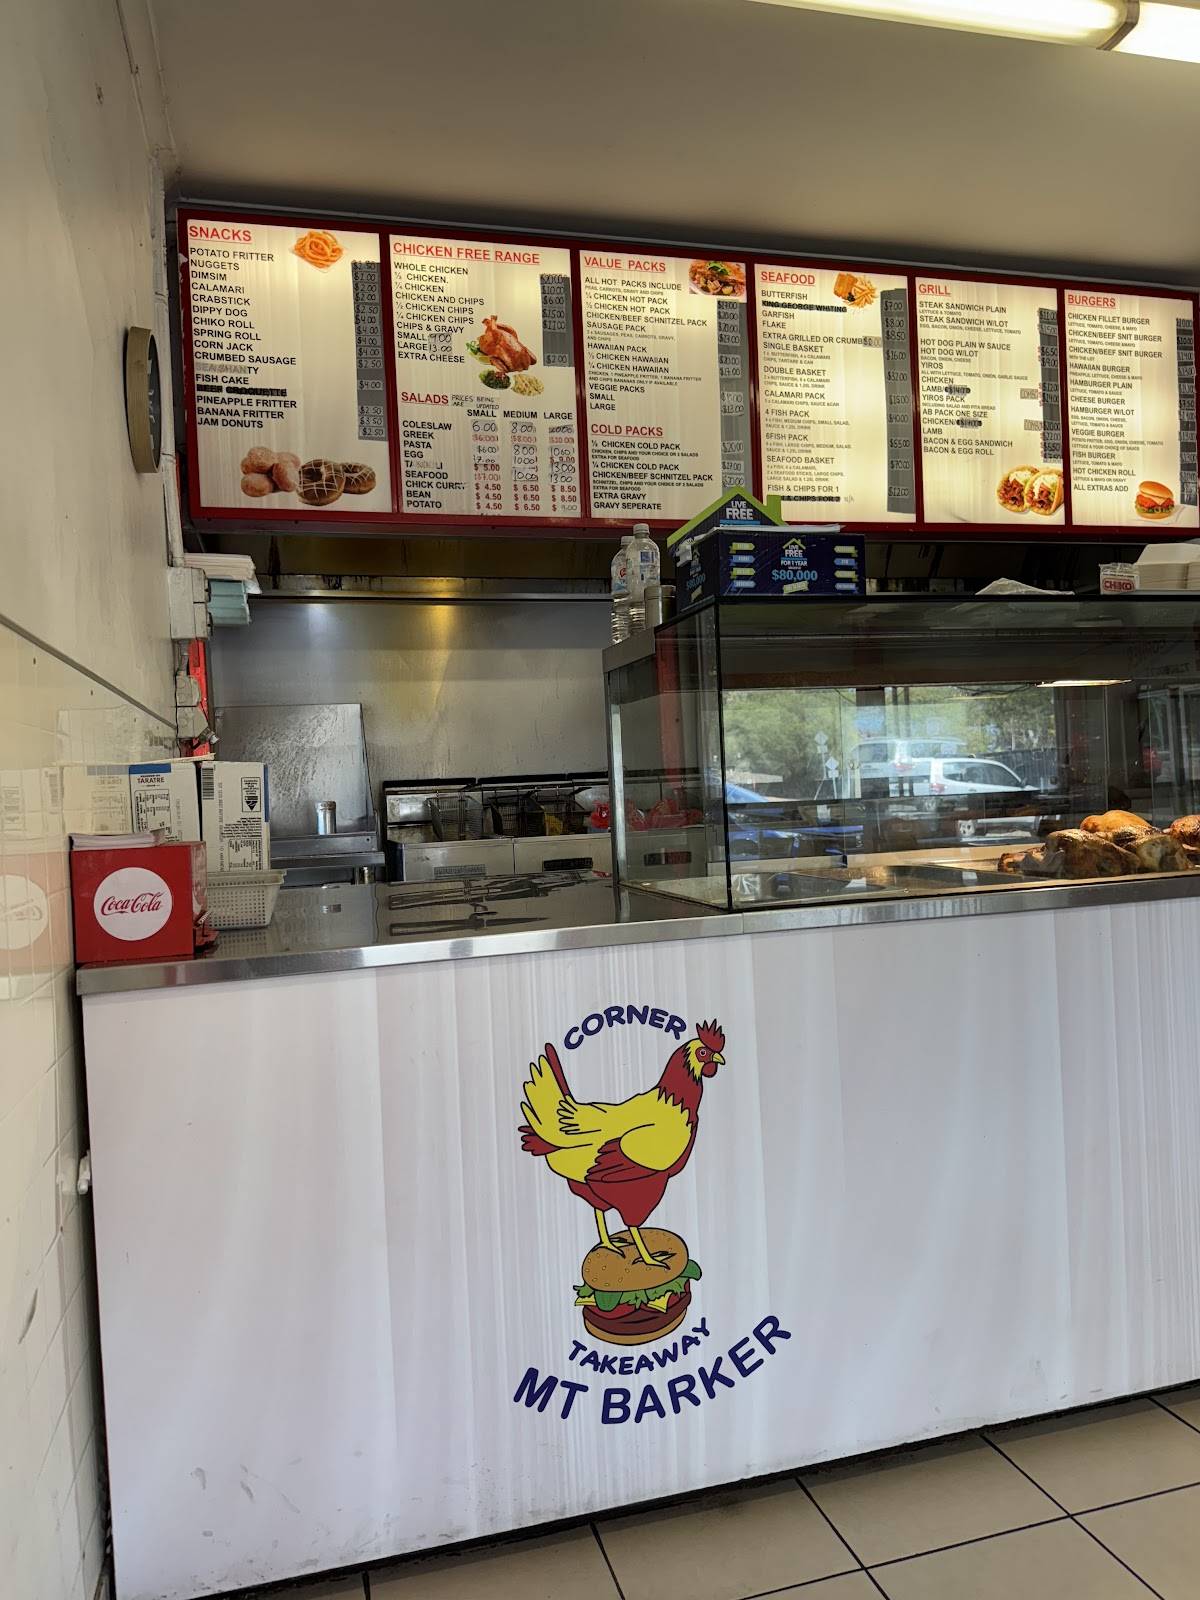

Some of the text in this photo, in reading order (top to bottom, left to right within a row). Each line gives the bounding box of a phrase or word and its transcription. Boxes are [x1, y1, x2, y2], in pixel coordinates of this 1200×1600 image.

[189, 226, 251, 241] SNACKS
[190, 248, 274, 261] POTATO FRITTER
[393, 243, 540, 263] CHICKEN FREE RANGE
[190, 259, 239, 270] NUGGETS
[394, 262, 468, 274] WHOLE CHICKEN
[584, 257, 666, 272] VALUE PACKS
[191, 271, 227, 281] DIMSIM
[761, 272, 815, 284] SEAFOOD
[192, 283, 244, 293] CALAMARI
[622, 280, 646, 288] PACKS
[649, 282, 681, 290] INCLUDE
[919, 284, 951, 295] GRILL
[192, 294, 250, 305] CRABSTICK
[762, 290, 807, 300] BUTTERFISH
[1068, 295, 1116, 307] BURGERS
[193, 306, 247, 316] DIPPY DOG
[946, 303, 984, 312] SANDWICH
[762, 310, 794, 319] GARFISH
[1068, 313, 1150, 325] CHICKEN FILLET BURGER
[193, 317, 254, 328] CHIKO ROLL
[397, 322, 423, 330] CHIPS
[435, 325, 464, 334] GRAVY
[587, 322, 623, 331] SAUSAGE
[763, 320, 786, 329] FLAKE
[194, 329, 261, 340] SPRING ROLL
[398, 332, 426, 341] SMALL
[1069, 330, 1116, 340] CHICKEN/BEEF
[1134, 334, 1162, 342] BURGER
[194, 340, 253, 351] CORN JACK
[398, 342, 428, 350] LARGE
[793, 344, 823, 352] BASKET
[920, 338, 935, 346] HOT
[987, 343, 1010, 351] SAUCE
[195, 352, 296, 365] CRUMBED SAUSAGE
[398, 352, 465, 363] EXTRA CHEESE
[764, 366, 826, 376] DOUBLE BASKET
[1070, 362, 1100, 371] HAWAIIAN
[196, 374, 249, 384] FISH CAKE
[922, 376, 954, 384] CHICKEN
[1070, 379, 1132, 389] HAMBURGER PLAIN
[401, 392, 449, 404] SALADS
[765, 390, 803, 398] CALAMARI
[197, 396, 296, 408] PINEAPPLE FRITTER
[1098, 397, 1125, 405] BURGER
[198, 407, 284, 418] BANANA FRITTER
[198, 418, 263, 428] JAM DONUTS
[403, 421, 452, 430] COLESLAW
[403, 431, 434, 439] GREEK
[591, 424, 663, 436] COLD PACKS
[405, 471, 448, 479] SEAFOOD
[593, 472, 648, 480] CHICKEN/BEEF
[1088, 468, 1116, 476] CHICKEN
[407, 500, 441, 508] POTATO
[726, 508, 753, 520] FREE
[772, 570, 818, 581] $80,000
[1104, 581, 1132, 590] CHIKO
[564, 1005, 687, 1050] CORNER
[567, 1317, 711, 1375] TAKEAWAY
[513, 1314, 792, 1425] MT BARKER
